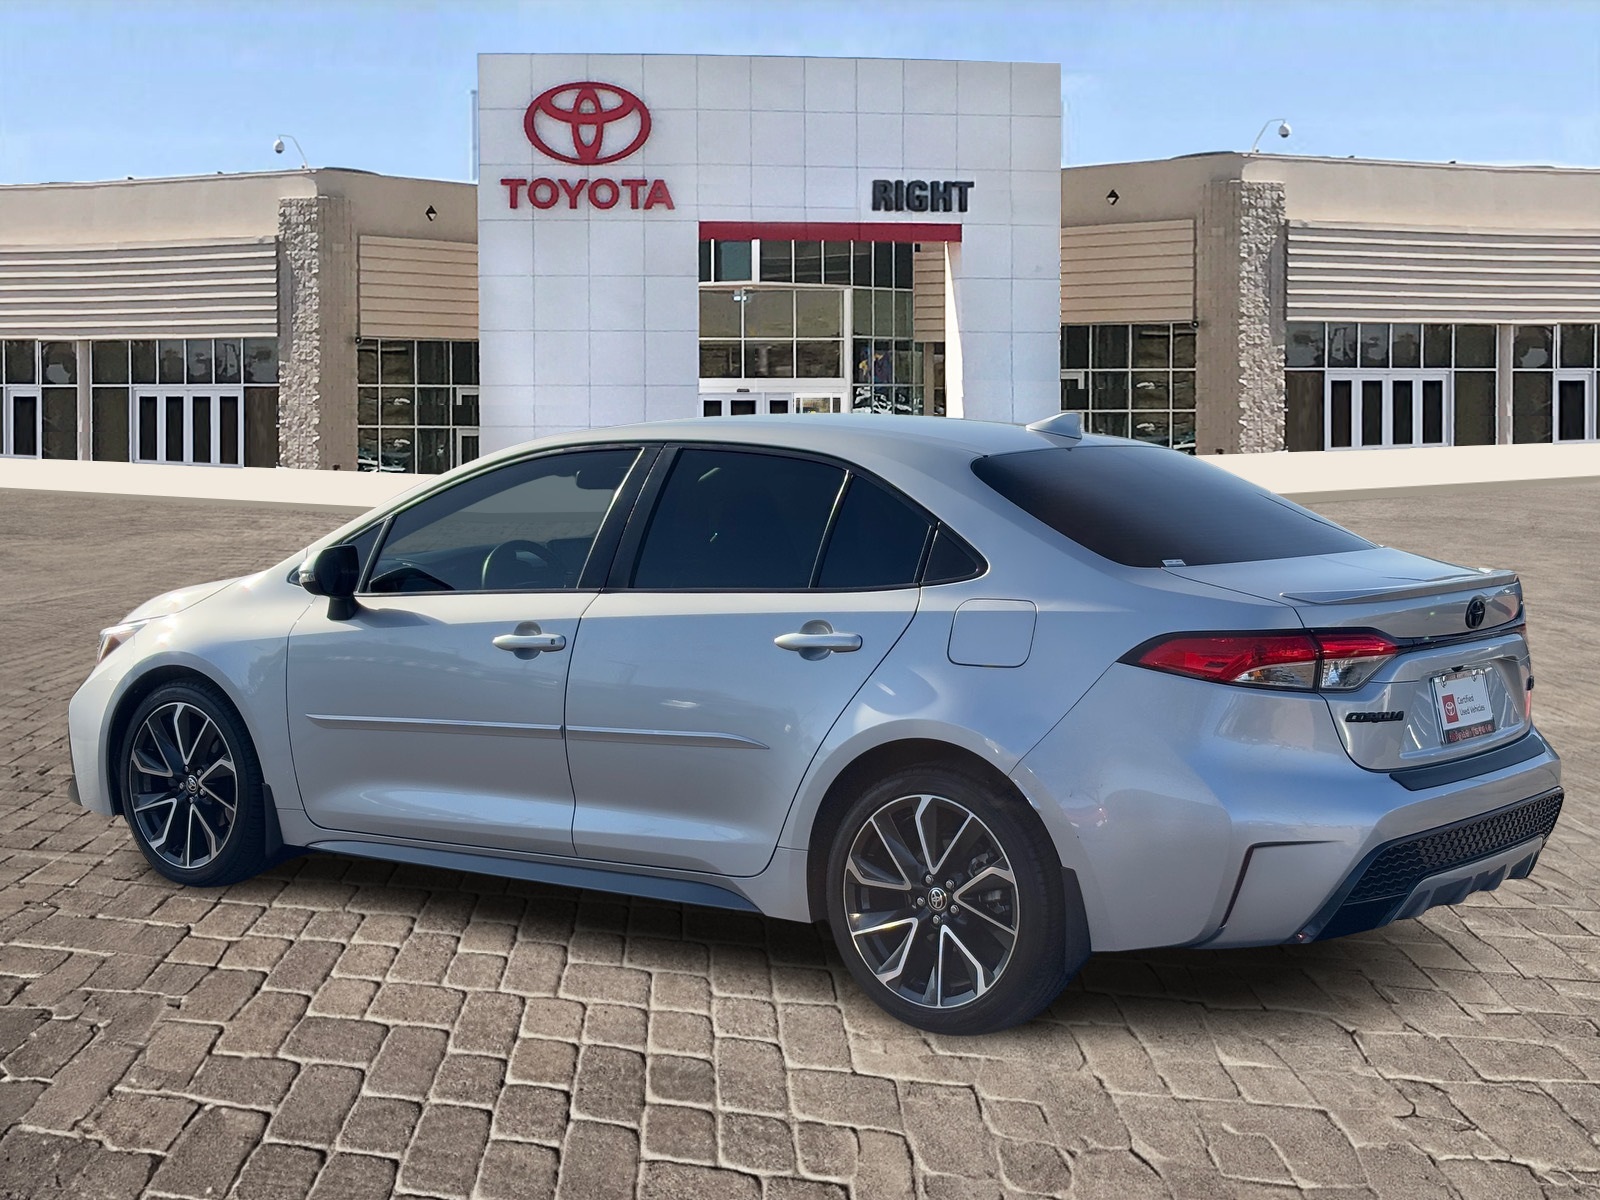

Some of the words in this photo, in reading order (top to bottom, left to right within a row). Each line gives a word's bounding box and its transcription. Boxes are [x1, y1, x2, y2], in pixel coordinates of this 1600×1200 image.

[500, 177, 675, 210] TOYOTA
[871, 179, 975, 212] RIGHT
[1456, 694, 1475, 705] Certified
